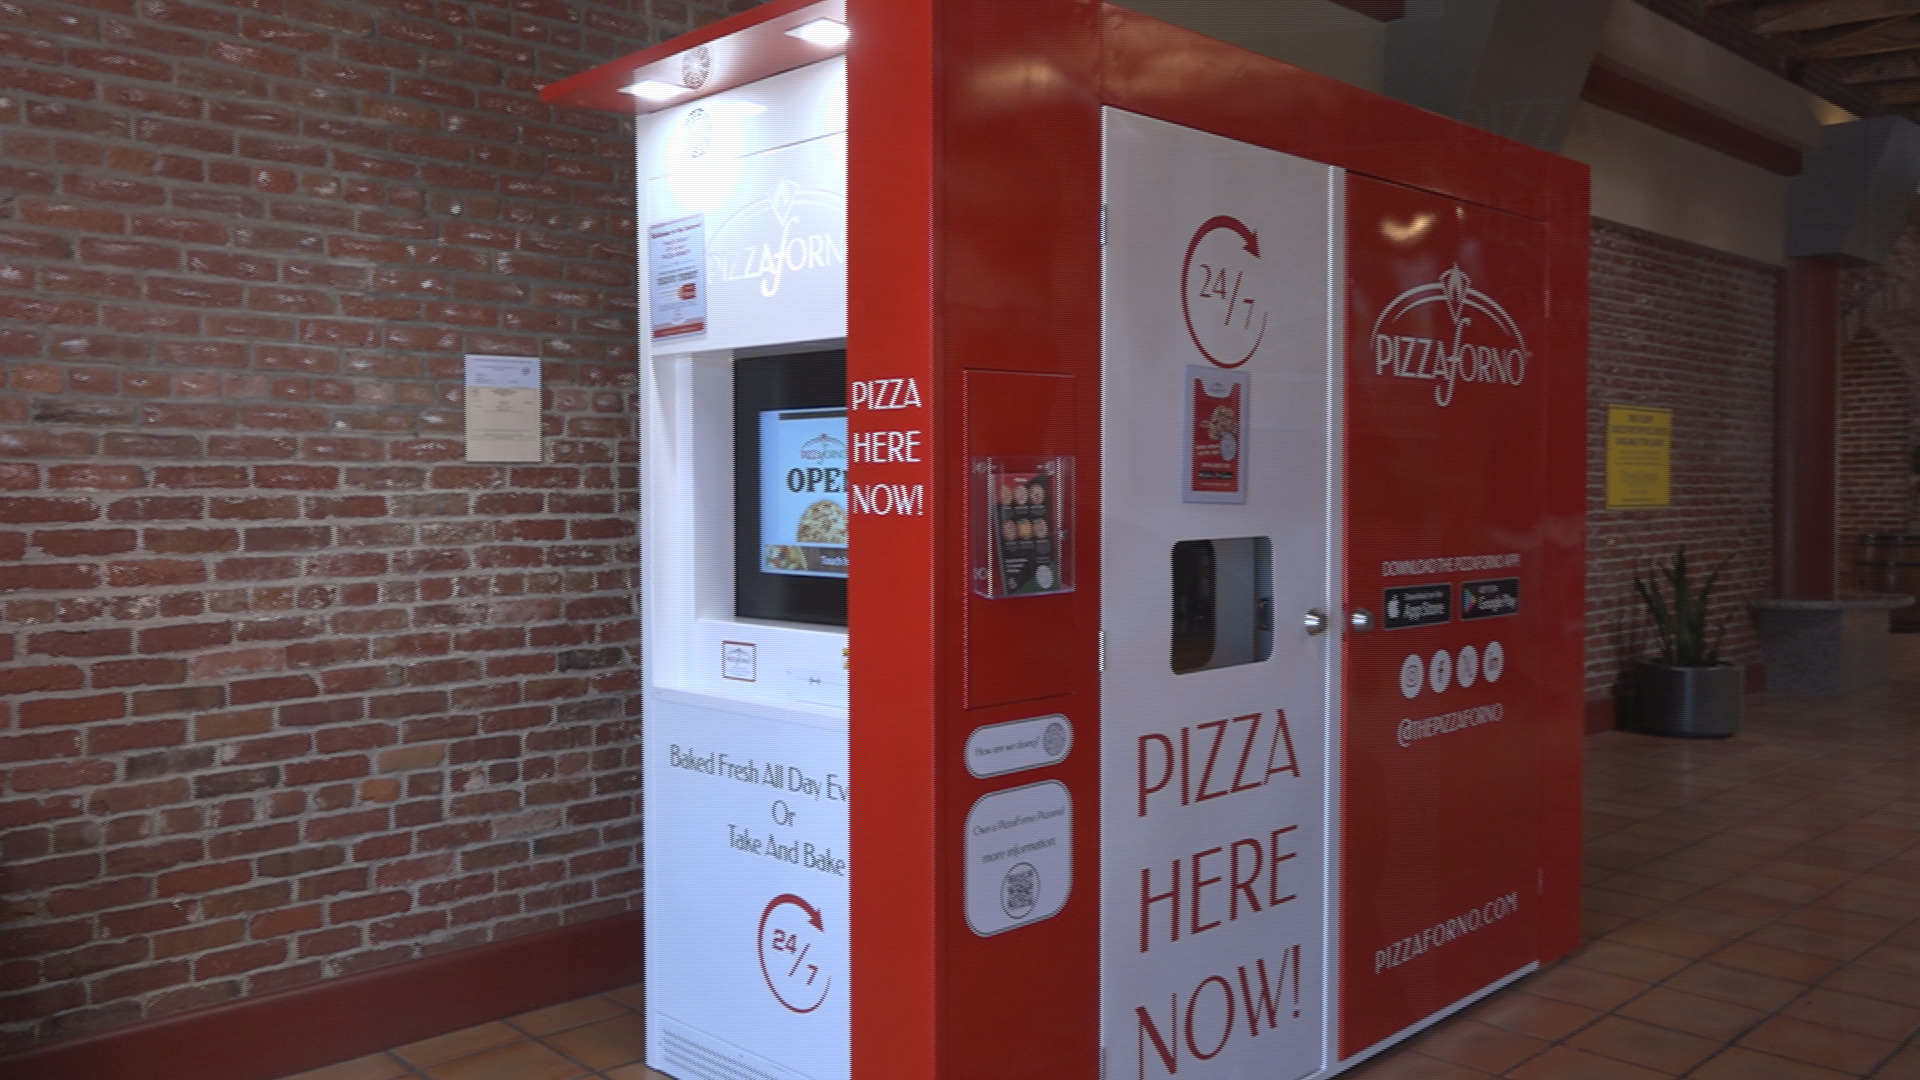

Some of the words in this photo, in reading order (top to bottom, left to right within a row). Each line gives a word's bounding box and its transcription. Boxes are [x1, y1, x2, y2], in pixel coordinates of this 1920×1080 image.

[1199, 263, 1255, 330] 24/7
[851, 378, 922, 410] PIZZA
[852, 430, 922, 463] HERE
[852, 484, 924, 516] NOW!
[1382, 558, 1436, 577] DOWNLOAD
[1436, 557, 1454, 573] THE
[1455, 555, 1503, 572] PIZZAFORNO
[1402, 602, 1422, 621] App
[1422, 600, 1445, 616] Store
[1478, 595, 1502, 612] Google
[1502, 593, 1517, 609] Play
[1397, 702, 1504, 747] @THEPIZZAFORNO
[670, 743, 714, 775] Baked
[718, 753, 759, 784] Fresh
[762, 762, 784, 790] All
[788, 766, 823, 801] Day
[826, 773, 848, 802] Ev
[1137, 708, 1301, 817] PIZZA
[771, 799, 796, 828] Or
[727, 823, 762, 856] Take
[765, 833, 799, 865] And
[803, 842, 846, 877] Bake
[982, 850, 1006, 864] more
[1139, 824, 1299, 953] HERE
[1374, 891, 1518, 975] PIZZAFORNO.COM
[771, 928, 819, 987] 24/7
[1134, 943, 1301, 1080] NOW!
